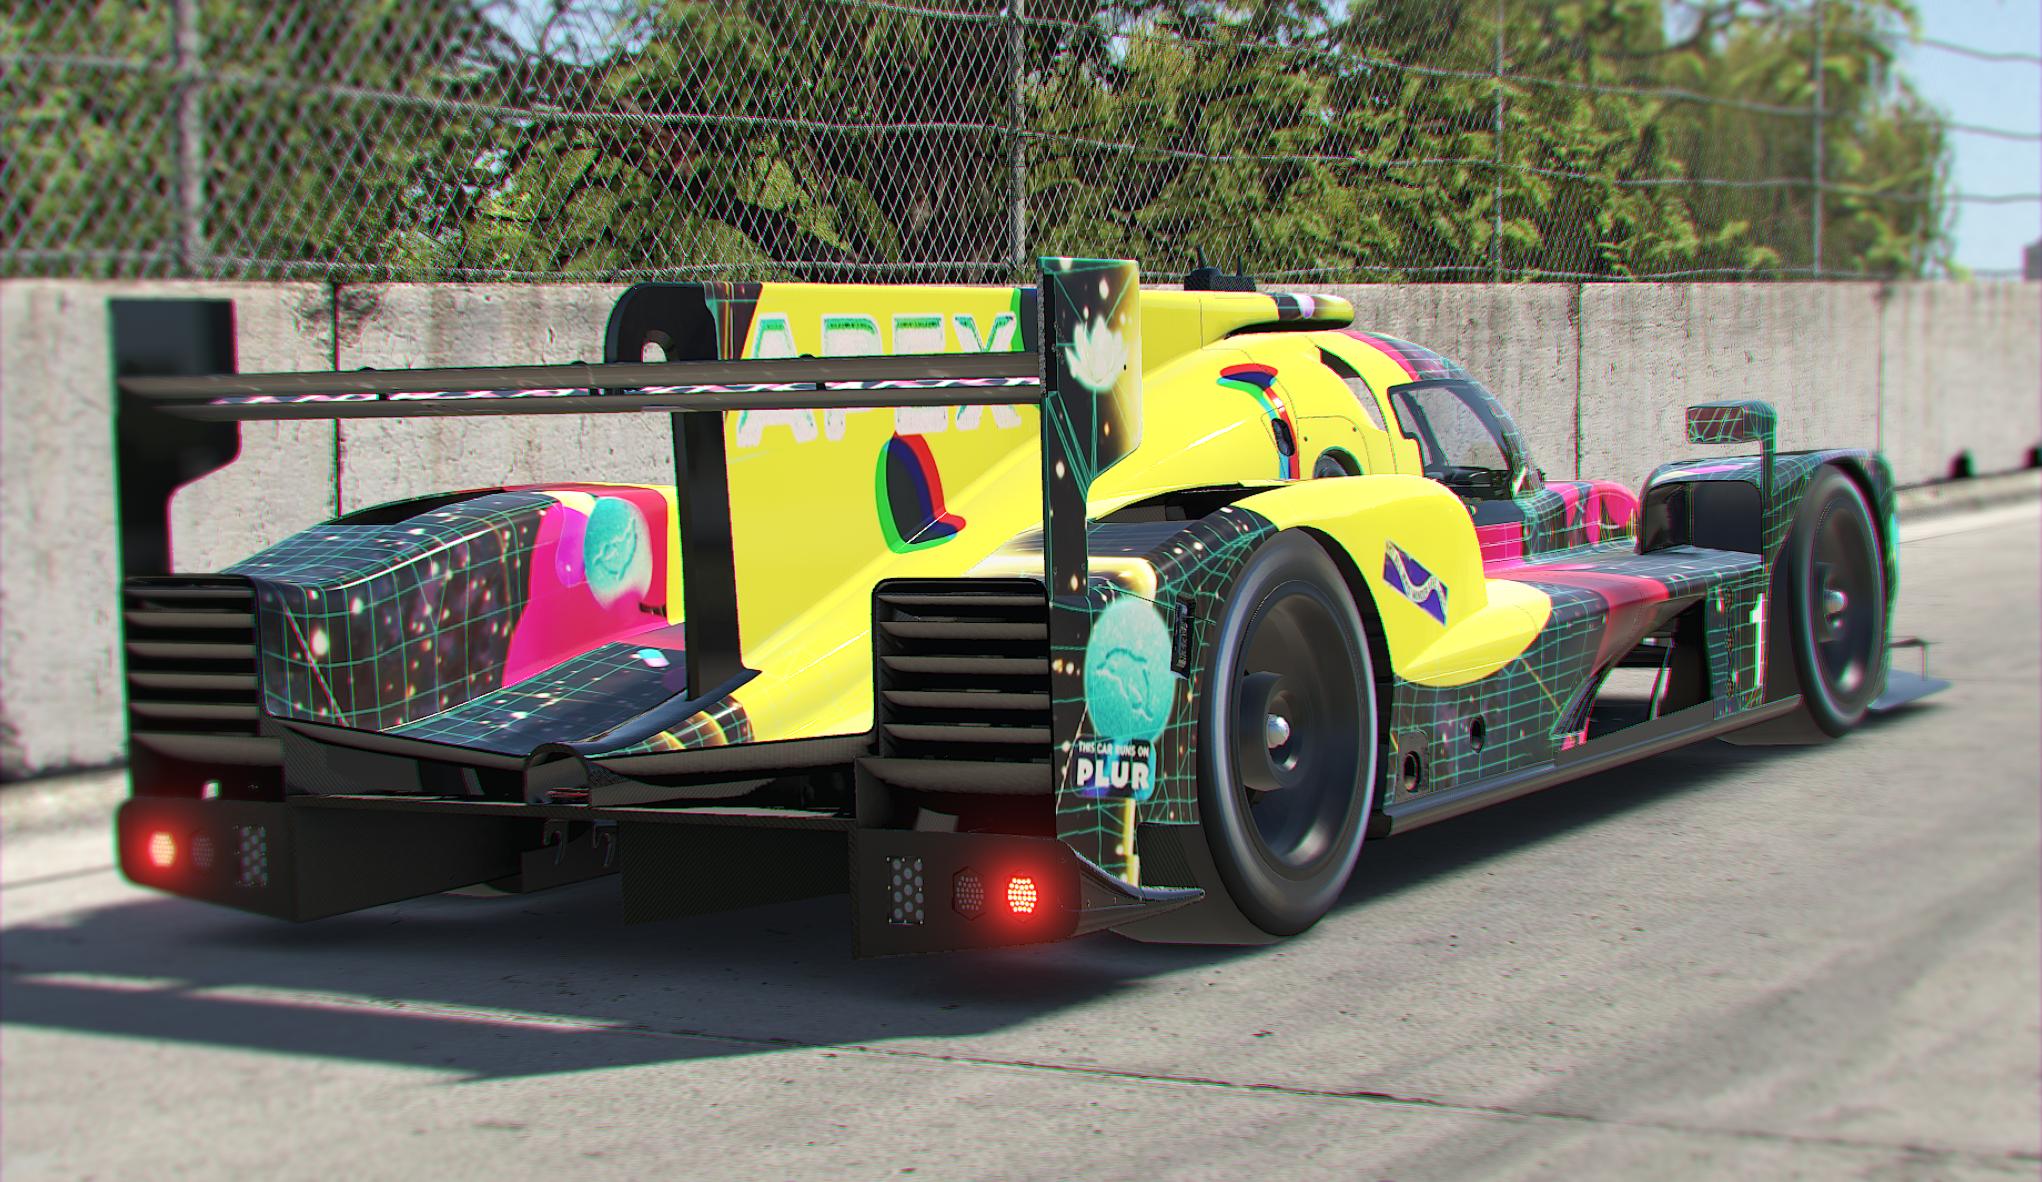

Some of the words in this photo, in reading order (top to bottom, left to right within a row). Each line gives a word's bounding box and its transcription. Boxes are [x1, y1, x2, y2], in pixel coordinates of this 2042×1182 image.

[735, 311, 1022, 448] APEX
[1078, 740, 1095, 754] THIS
[1097, 742, 1113, 757] CAR
[1115, 744, 1136, 757] RUNS
[1137, 745, 1150, 758] ON
[1076, 757, 1150, 791] PLUR
